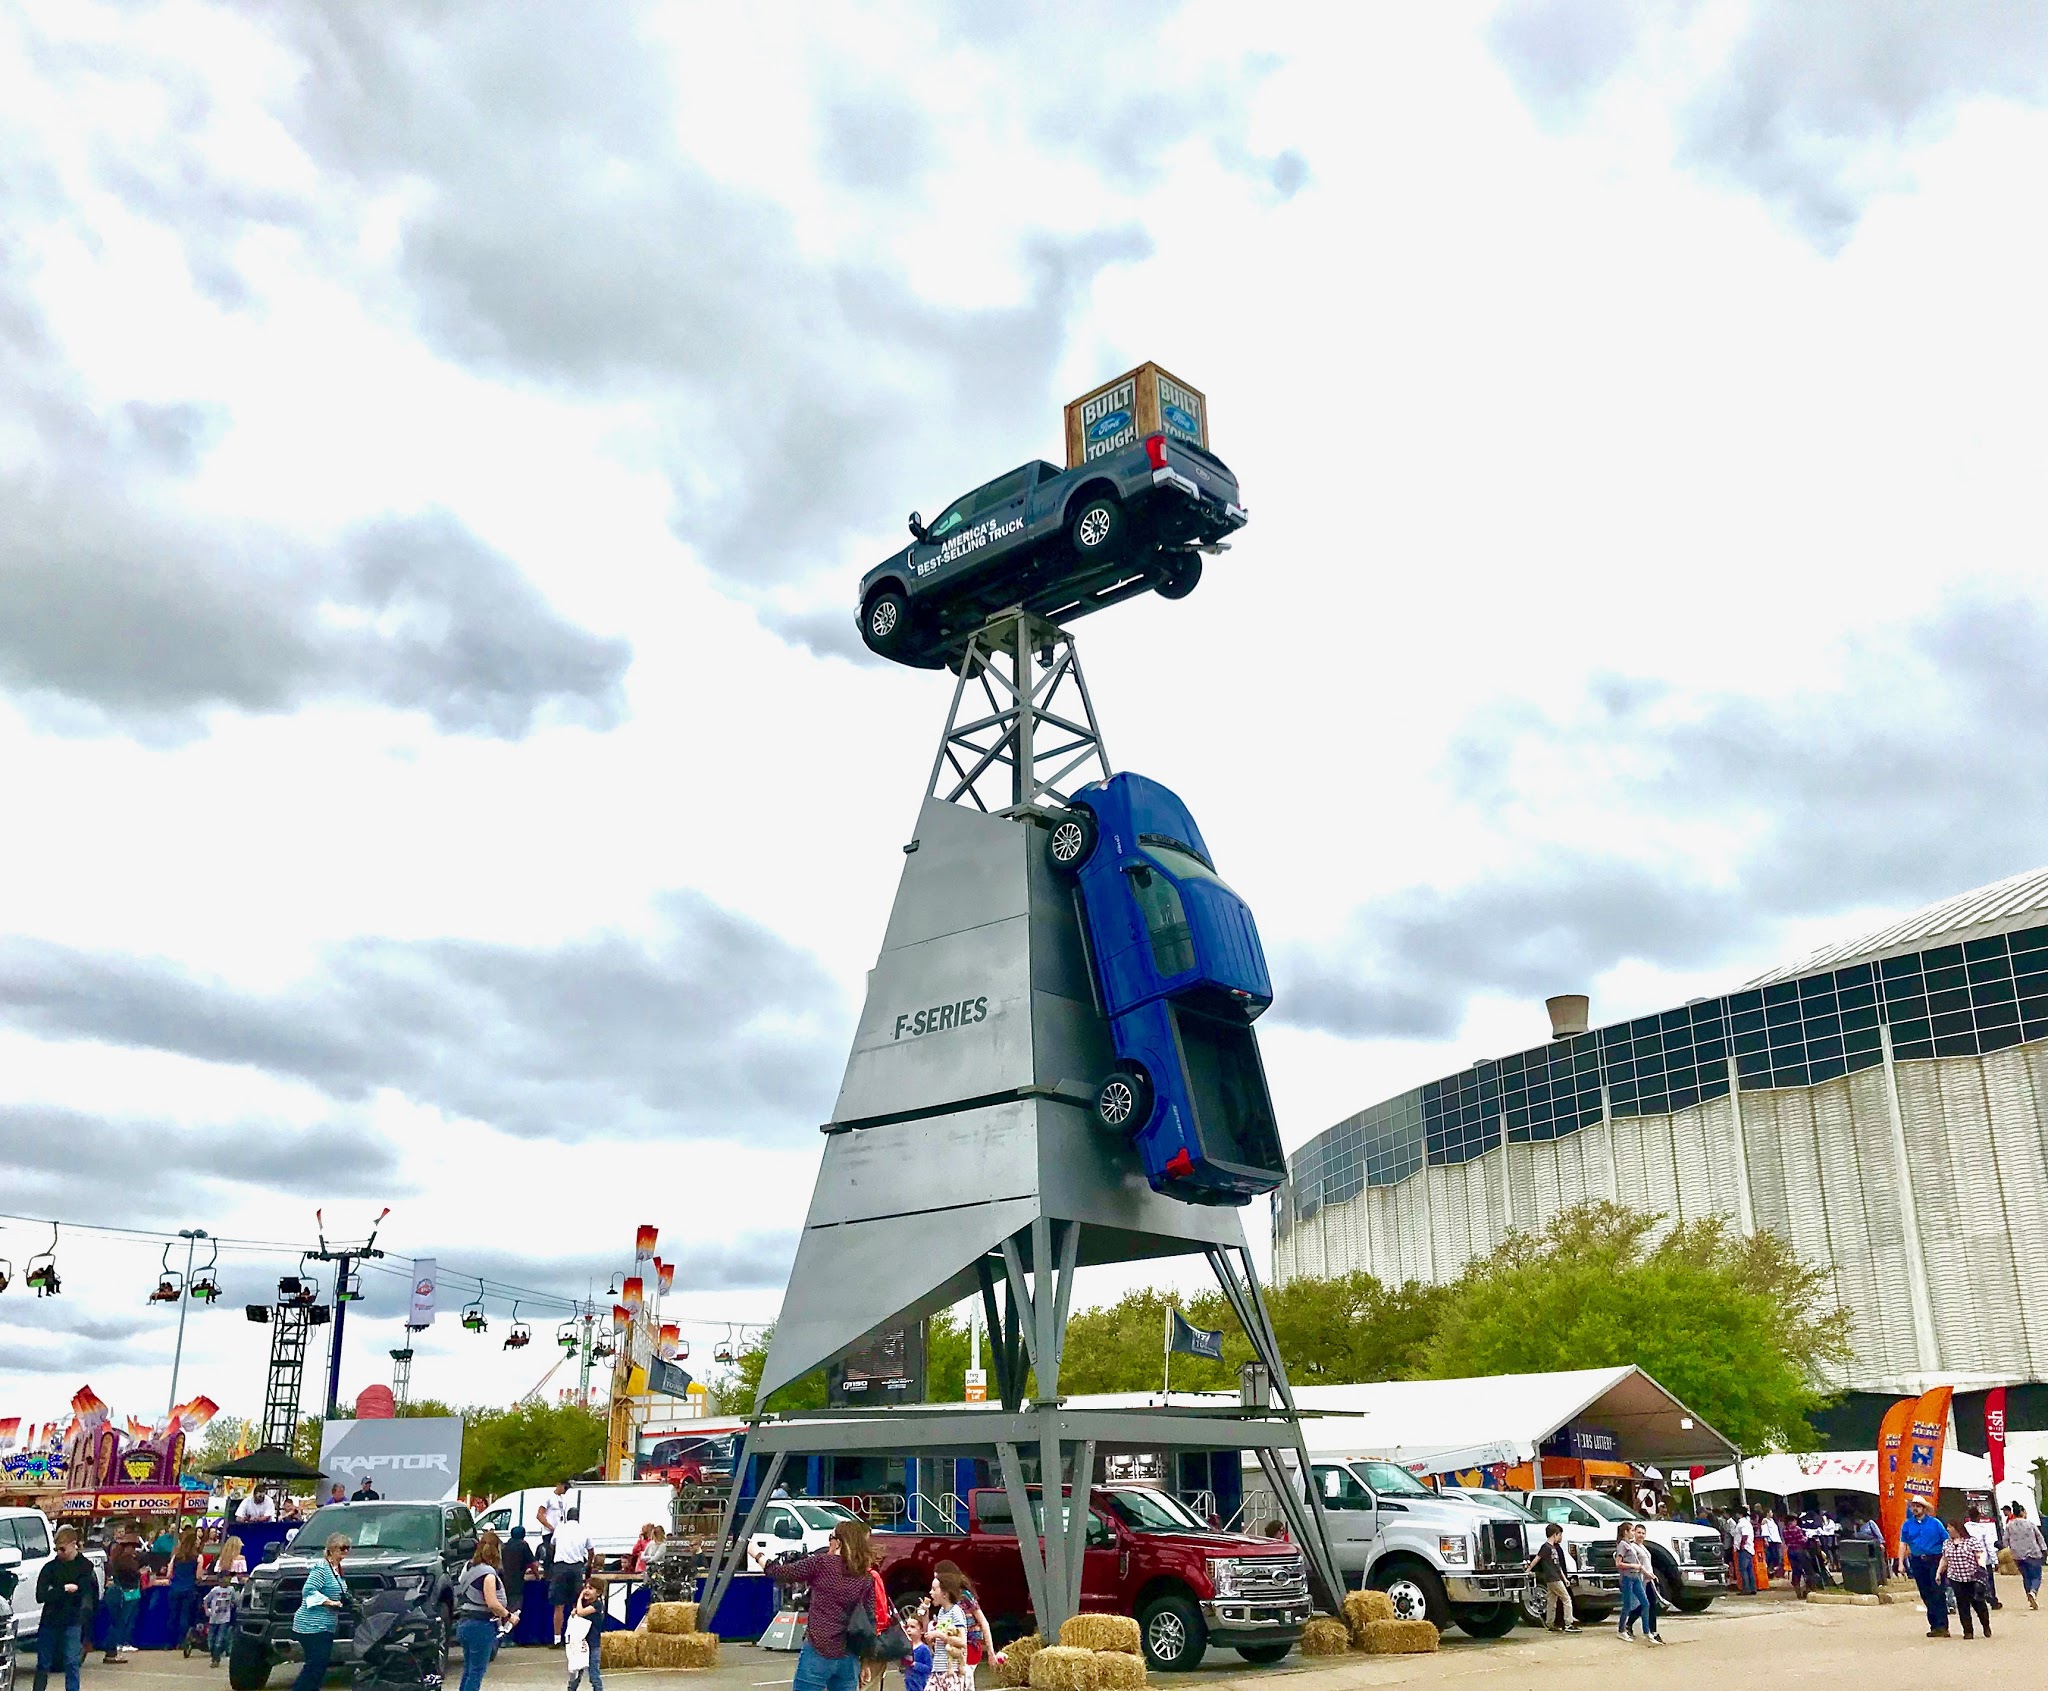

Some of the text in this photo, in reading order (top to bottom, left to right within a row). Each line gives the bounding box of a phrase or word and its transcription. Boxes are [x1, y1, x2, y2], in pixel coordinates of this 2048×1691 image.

[1086, 385, 1131, 425] BUILT
[1160, 380, 1198, 419] BUILT
[1098, 418, 1120, 436] Ford
[1171, 409, 1192, 430] Ford
[1087, 426, 1136, 461] TOUGH
[917, 516, 1024, 577] BEST-SELLING TRUCK
[941, 518, 997, 554] AMERICA'S
[894, 996, 988, 1040] F-SERIES
[1914, 1419, 1941, 1430] PLAY
[1987, 1410, 2004, 1442] dish
[330, 1453, 451, 1477] RAPTOR
[1906, 1475, 1934, 1485] PLAY
[112, 1499, 170, 1508] HOT DOGS
